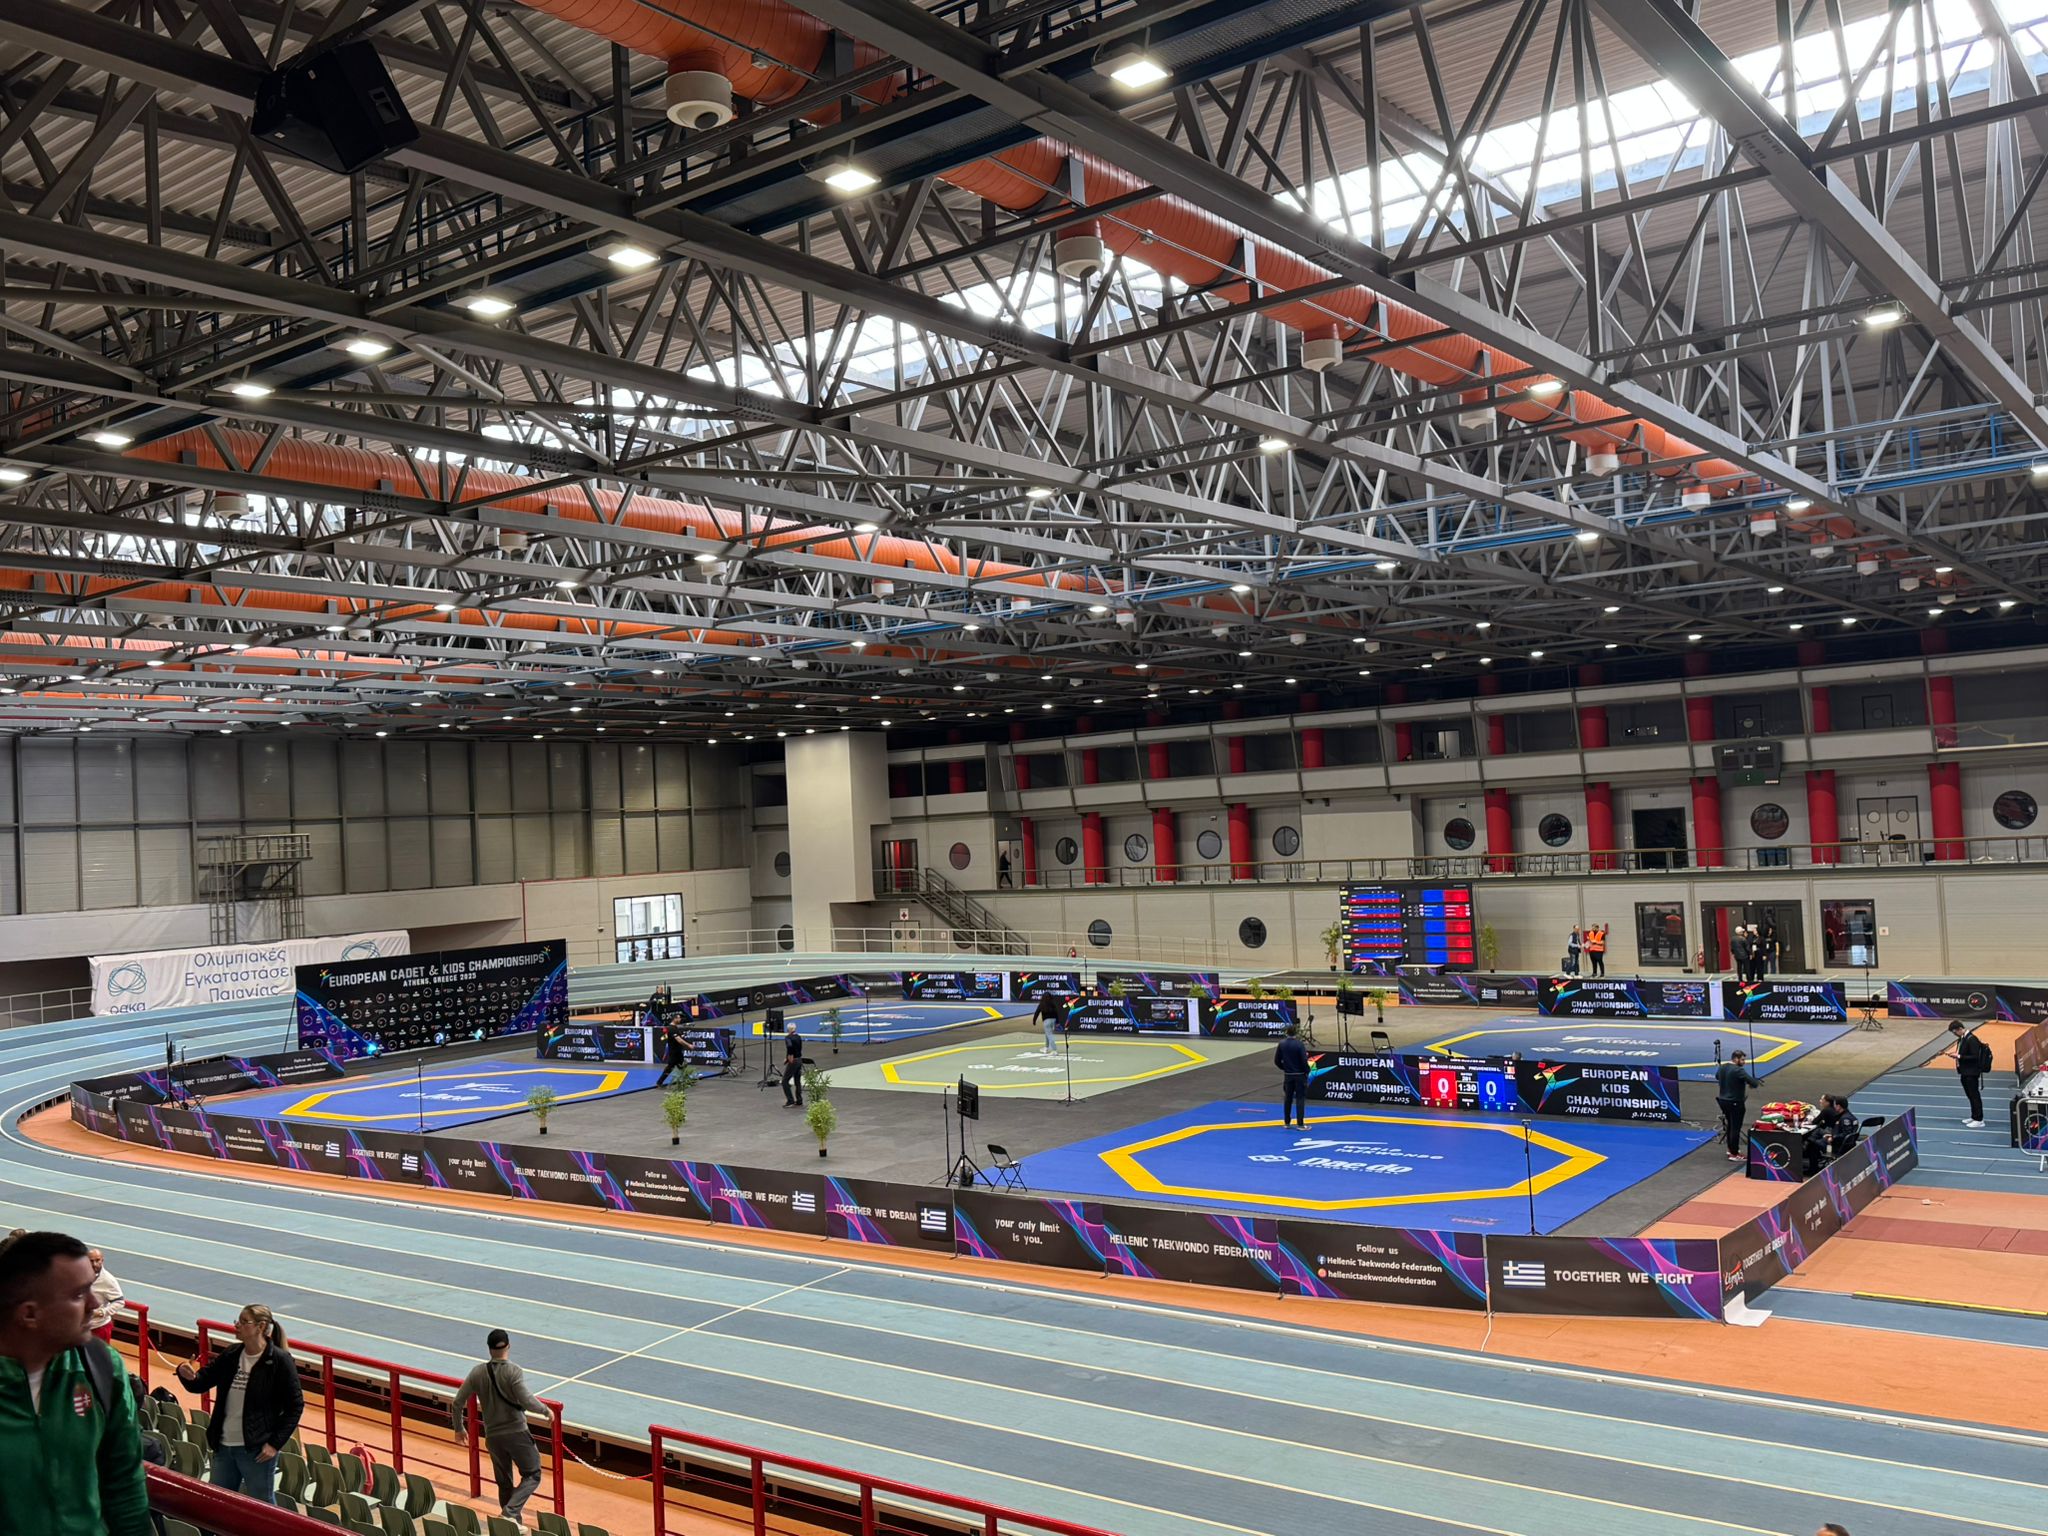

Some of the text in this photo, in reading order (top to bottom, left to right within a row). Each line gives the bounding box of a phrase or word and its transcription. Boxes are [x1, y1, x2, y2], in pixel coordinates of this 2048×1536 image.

[194, 947, 286, 968] Ολυμπιακές
[329, 953, 545, 988] EUROPEAN CADET & KIDS CHAMPIONSHIPS
[1360, 964, 1367, 974] 2
[1414, 967, 1420, 976] 3
[185, 966, 294, 988] Εγκαταστάσει
[402, 972, 477, 988] ATHENS, GREECE 2025
[209, 983, 280, 1002] Παιανίας
[1582, 982, 1628, 991] EUROPEAN
[1772, 984, 1824, 994] EUROPEAN
[1594, 992, 1615, 1000] KIDS
[1787, 995, 1810, 1003] KIDS
[1929, 997, 1941, 1005] WE
[1942, 997, 1966, 1005] DREAM
[1088, 999, 1124, 1008] EUROPEAN
[1238, 1001, 1279, 1011] EUROPEAN
[1571, 1000, 1640, 1010] CHAMPIONSHIPS
[1760, 1004, 1839, 1014] CHAMPIONSHIPS
[1098, 1008, 1114, 1016] KIDS
[1250, 1012, 1268, 1020] KIDS
[1079, 1017, 1134, 1025] CHAMPIONSHIPS
[564, 1027, 593, 1036] EUROPEAN
[1338, 1057, 1394, 1069] EUROPEAN
[1354, 1070, 1379, 1080] KIDS
[1581, 1068, 1649, 1081] EUROPEAN
[1325, 1081, 1411, 1095] CHAMPIONSHIPS
[1437, 1077, 1449, 1094] 0
[1457, 1083, 1477, 1092] 1:30
[1485, 1080, 1497, 1096] 0
[1601, 1083, 1630, 1094] KIDS
[1324, 1091, 1354, 1099] ATHENS
[1566, 1095, 1669, 1110] CHAMPIONSHIPS
[1565, 1106, 1600, 1115] ATHENS
[352, 1148, 400, 1161] TOGETHER WE FIGHT
[448, 1157, 487, 1168] your only limit
[1297, 1157, 1413, 1173] Daedo
[464, 1169, 477, 1178] you.
[514, 1167, 603, 1184] HELLENIC TAEKWONDO FEDERATION
[719, 1187, 788, 1204] TOGETHER WE FIGHT
[835, 1203, 918, 1222] TOGETHER WE DREAM
[995, 1217, 1061, 1233] your only limit
[1012, 1232, 1043, 1246] is you.
[1109, 1233, 1273, 1261] HELLENIC TAEKWONDO FEDERATION
[1356, 1243, 1399, 1255] Follow us
[1742, 1248, 1764, 1271] TOGETHER
[1764, 1242, 1772, 1256] WE
[1327, 1256, 1357, 1266] Hellenic
[1357, 1258, 1400, 1270] Taekwondo
[1401, 1262, 1443, 1273] Federation
[1328, 1270, 1437, 1287] hellenictaekwondofederation
[1553, 1269, 1695, 1286] TOGETHER WE FIGHT
